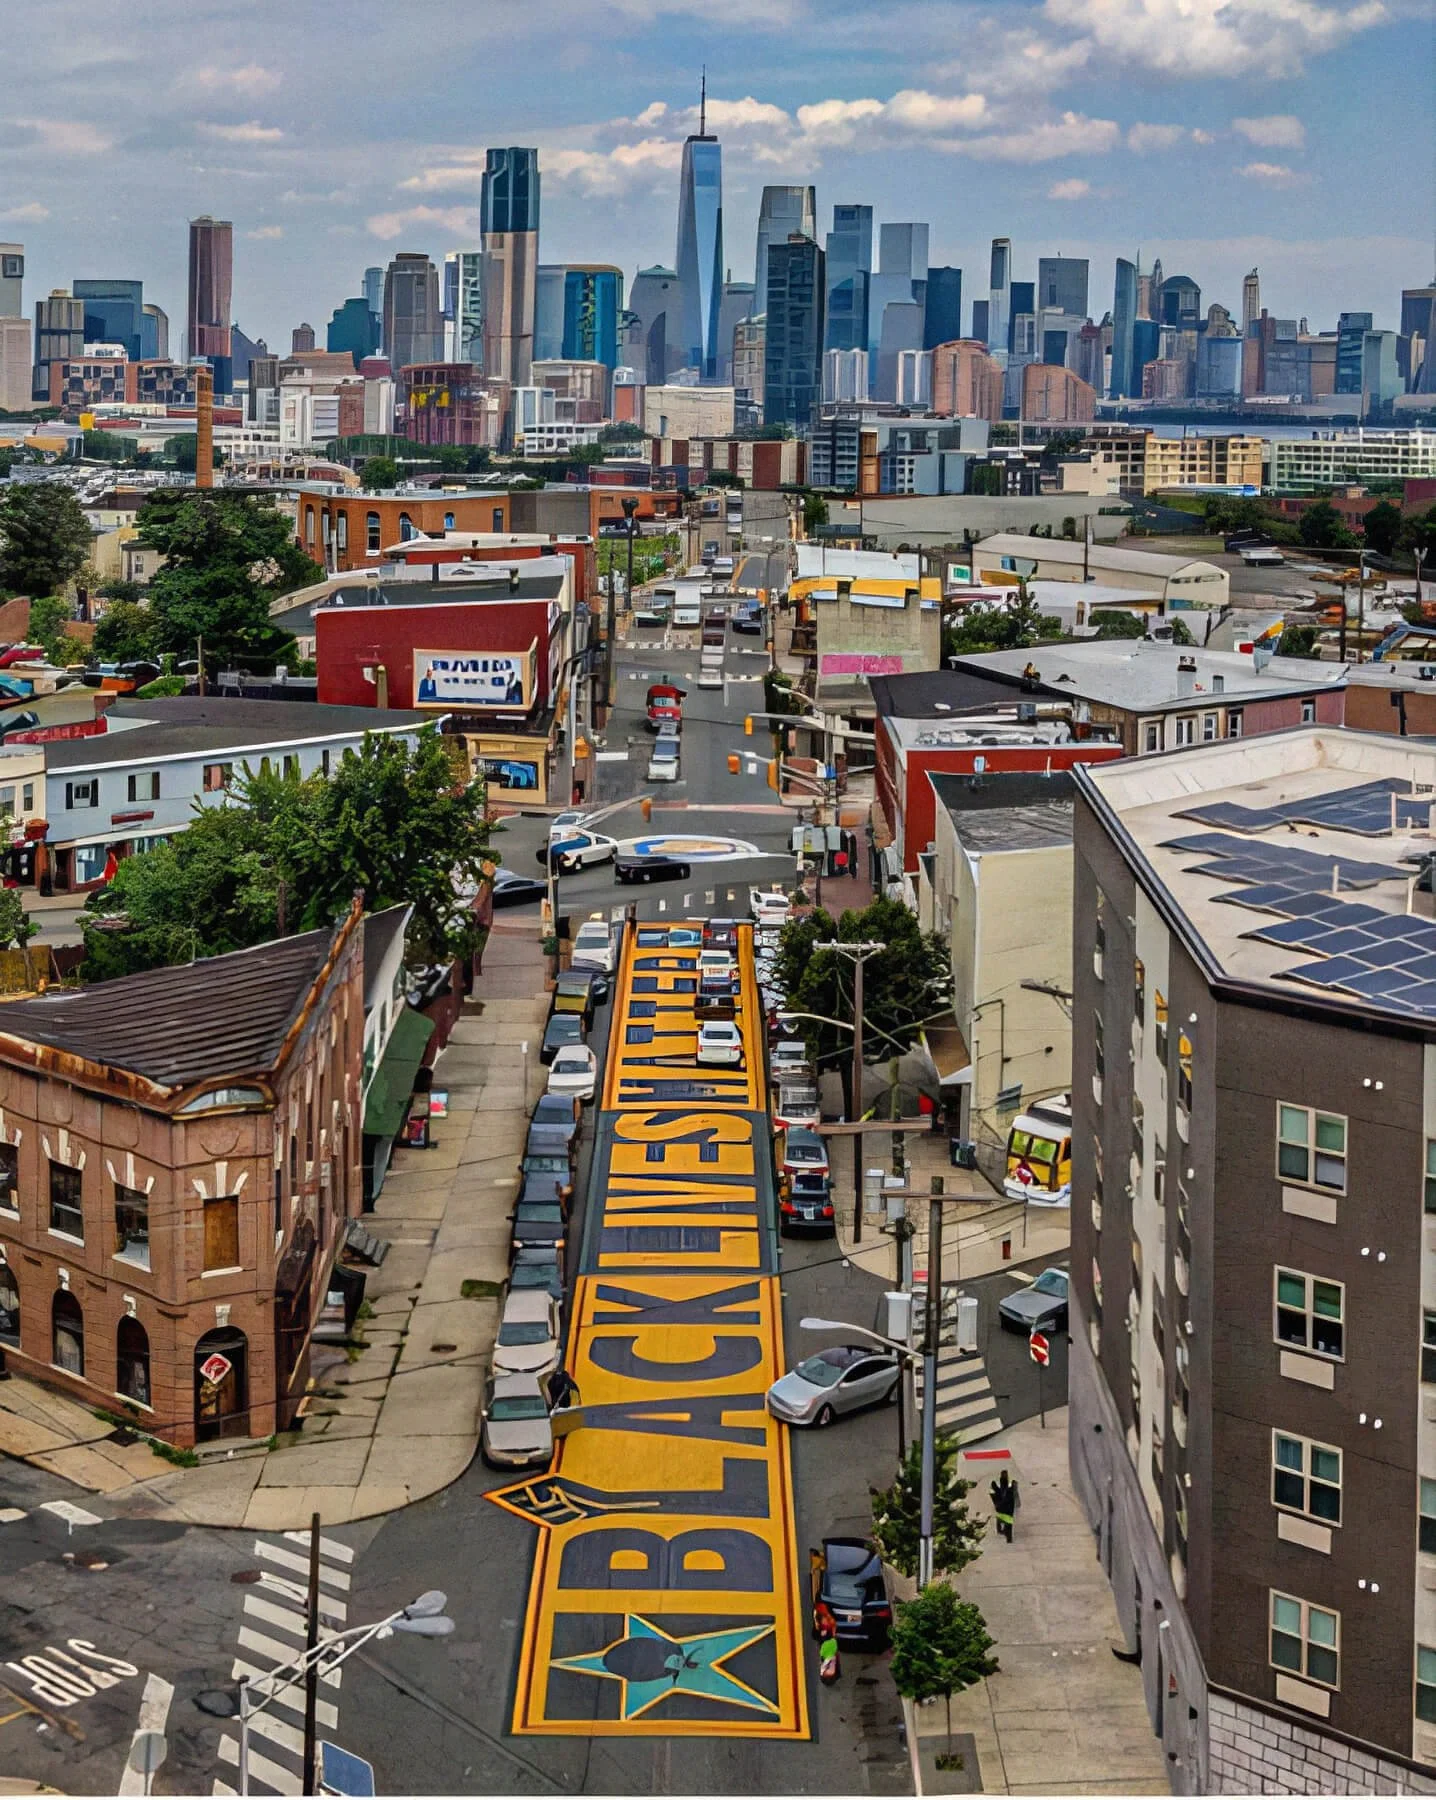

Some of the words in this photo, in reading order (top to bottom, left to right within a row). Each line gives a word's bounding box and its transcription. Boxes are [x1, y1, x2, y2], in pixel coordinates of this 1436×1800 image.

[598, 1111, 760, 1267] LIVES
[556, 1279, 774, 1593] BLACK
[5, 1638, 139, 1706] STOP
